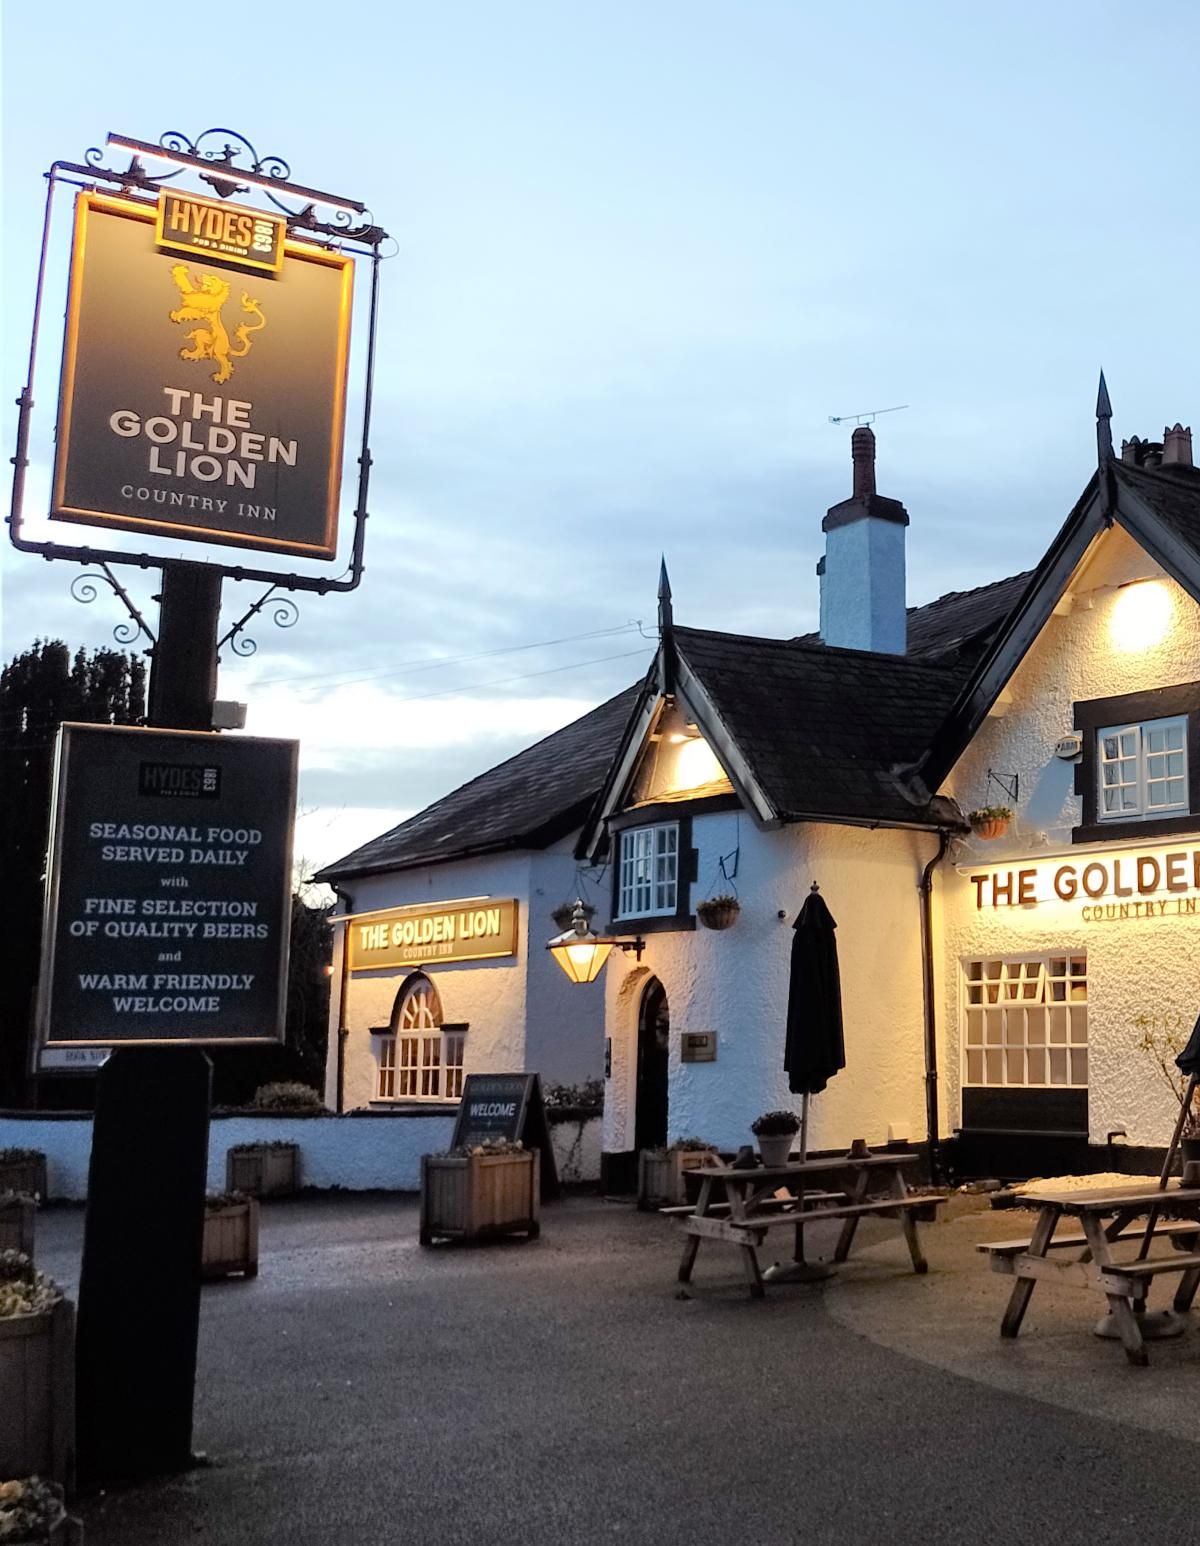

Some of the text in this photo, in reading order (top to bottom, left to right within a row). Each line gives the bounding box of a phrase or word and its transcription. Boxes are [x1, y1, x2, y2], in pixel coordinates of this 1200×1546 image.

[171, 199, 253, 248] HYDES
[252, 219, 274, 252] 1863
[164, 387, 252, 429] THE
[109, 410, 298, 467] GOLDEN
[149, 446, 257, 489] LION
[121, 484, 278, 521] COUNTRY INN
[144, 767, 201, 789] HYDES
[203, 768, 217, 792] 1863
[90, 822, 262, 845] SEASONAL FOOD
[102, 846, 248, 865] SERVED DAILY
[160, 876, 189, 888] with
[971, 869, 1039, 909] THE
[84, 899, 258, 916] FINE SELECTION
[1082, 899, 1167, 921] COUNTRY
[70, 921, 269, 939] OF QUALITY BEERS
[360, 909, 500, 950] THE GOLDEN LION
[158, 951, 182, 962] and
[403, 943, 453, 959] COUNTRY INN
[79, 974, 255, 990] WARM FRIENDLY
[113, 997, 220, 1012] WELCOME
[470, 1103, 516, 1117] WELCOME
